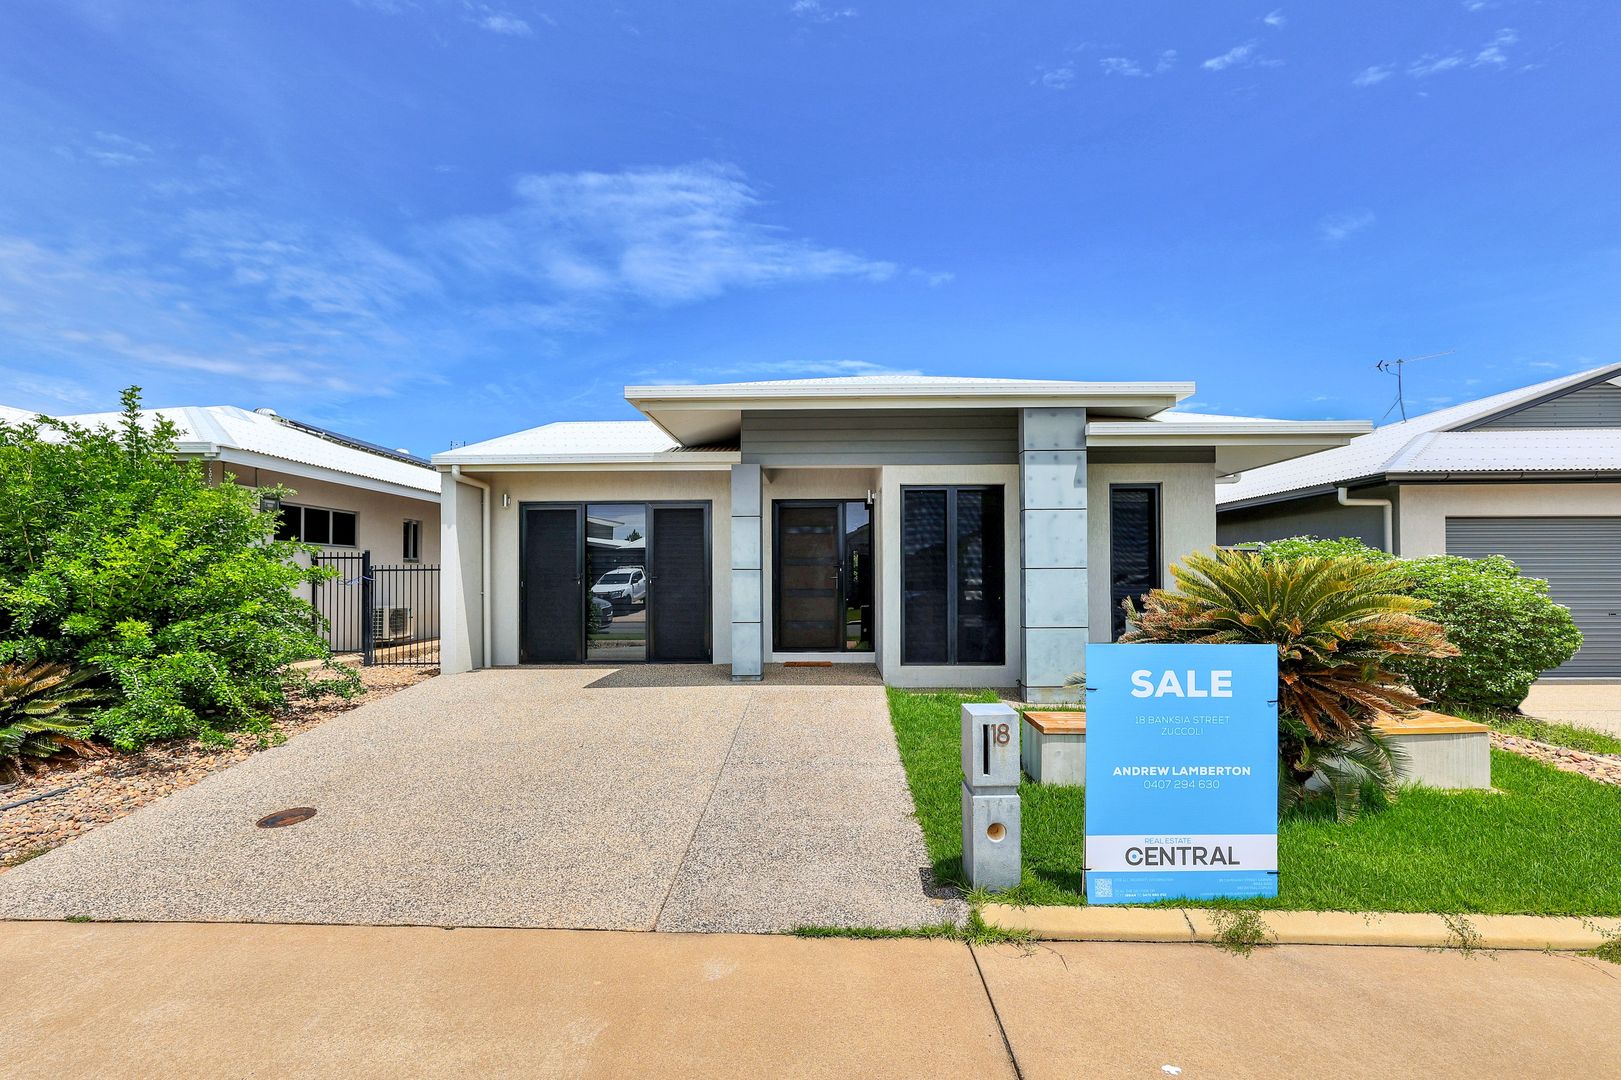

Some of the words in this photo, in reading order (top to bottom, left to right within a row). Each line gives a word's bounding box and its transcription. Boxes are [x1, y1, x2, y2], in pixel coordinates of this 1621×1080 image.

[1131, 669, 1233, 698] SALE
[1136, 716, 1146, 724] 18
[1148, 716, 1191, 724] BANKSIA
[1193, 716, 1230, 724] STREET
[991, 723, 1010, 745] 18
[1161, 727, 1204, 736] ZUCCOLI
[1113, 767, 1169, 776] ANDREW
[1172, 767, 1251, 776] LAMBERTON
[1143, 780, 1171, 789] 0407
[1174, 780, 1195, 789] 294
[1198, 780, 1220, 789] 630
[1125, 846, 1240, 866] CENTRAL
